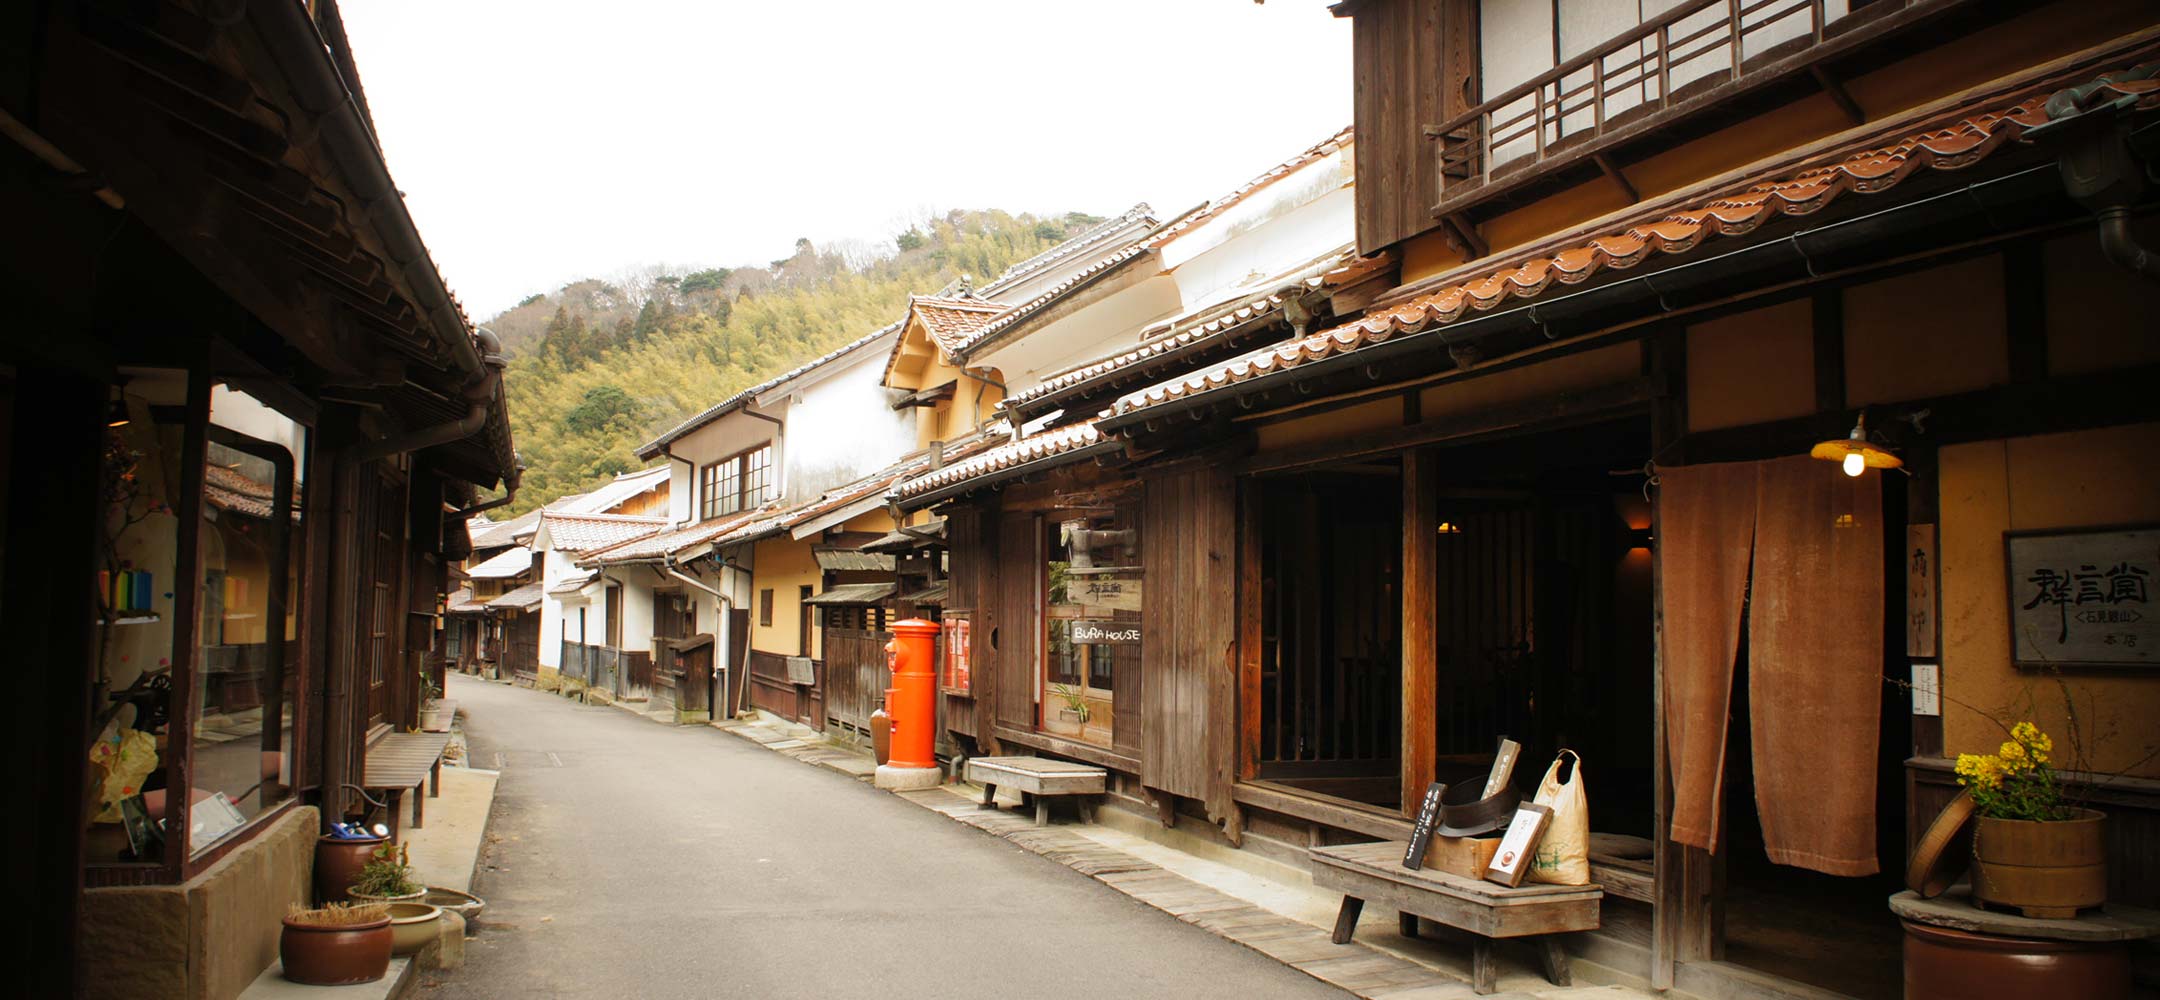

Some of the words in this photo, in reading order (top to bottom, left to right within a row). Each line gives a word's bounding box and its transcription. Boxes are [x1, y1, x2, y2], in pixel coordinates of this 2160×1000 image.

[2024, 562, 2149, 644] 群言堂
[1105, 629, 1141, 640] HOUSE
[2104, 632, 2138, 647] 本店
